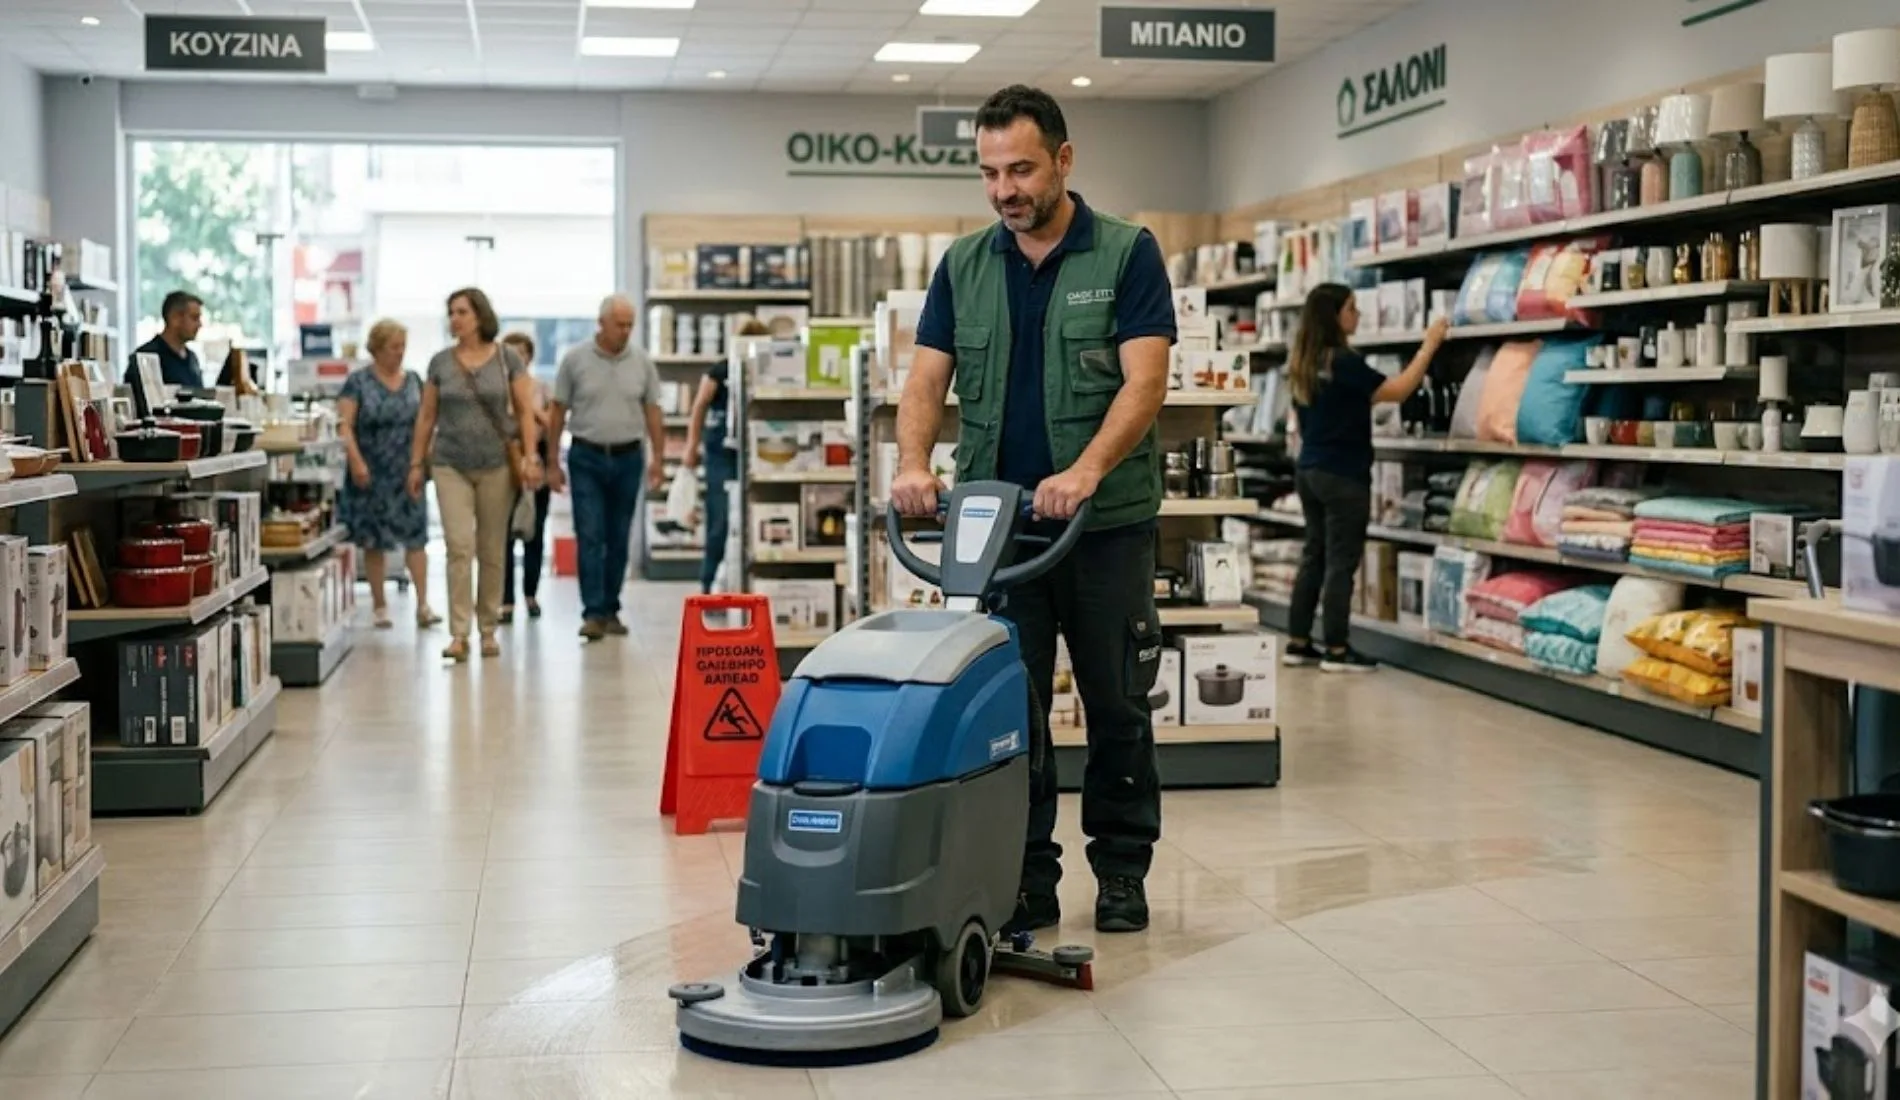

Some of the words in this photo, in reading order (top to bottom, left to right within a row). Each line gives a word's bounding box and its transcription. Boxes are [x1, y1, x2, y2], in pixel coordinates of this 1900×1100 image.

[169, 31, 303, 58] ΚΟΥΖΙΝΑ
[1130, 21, 1246, 48] ΜΠΑΝΙΟ
[1362, 42, 1446, 115] ΣΑΛΟΝΙ
